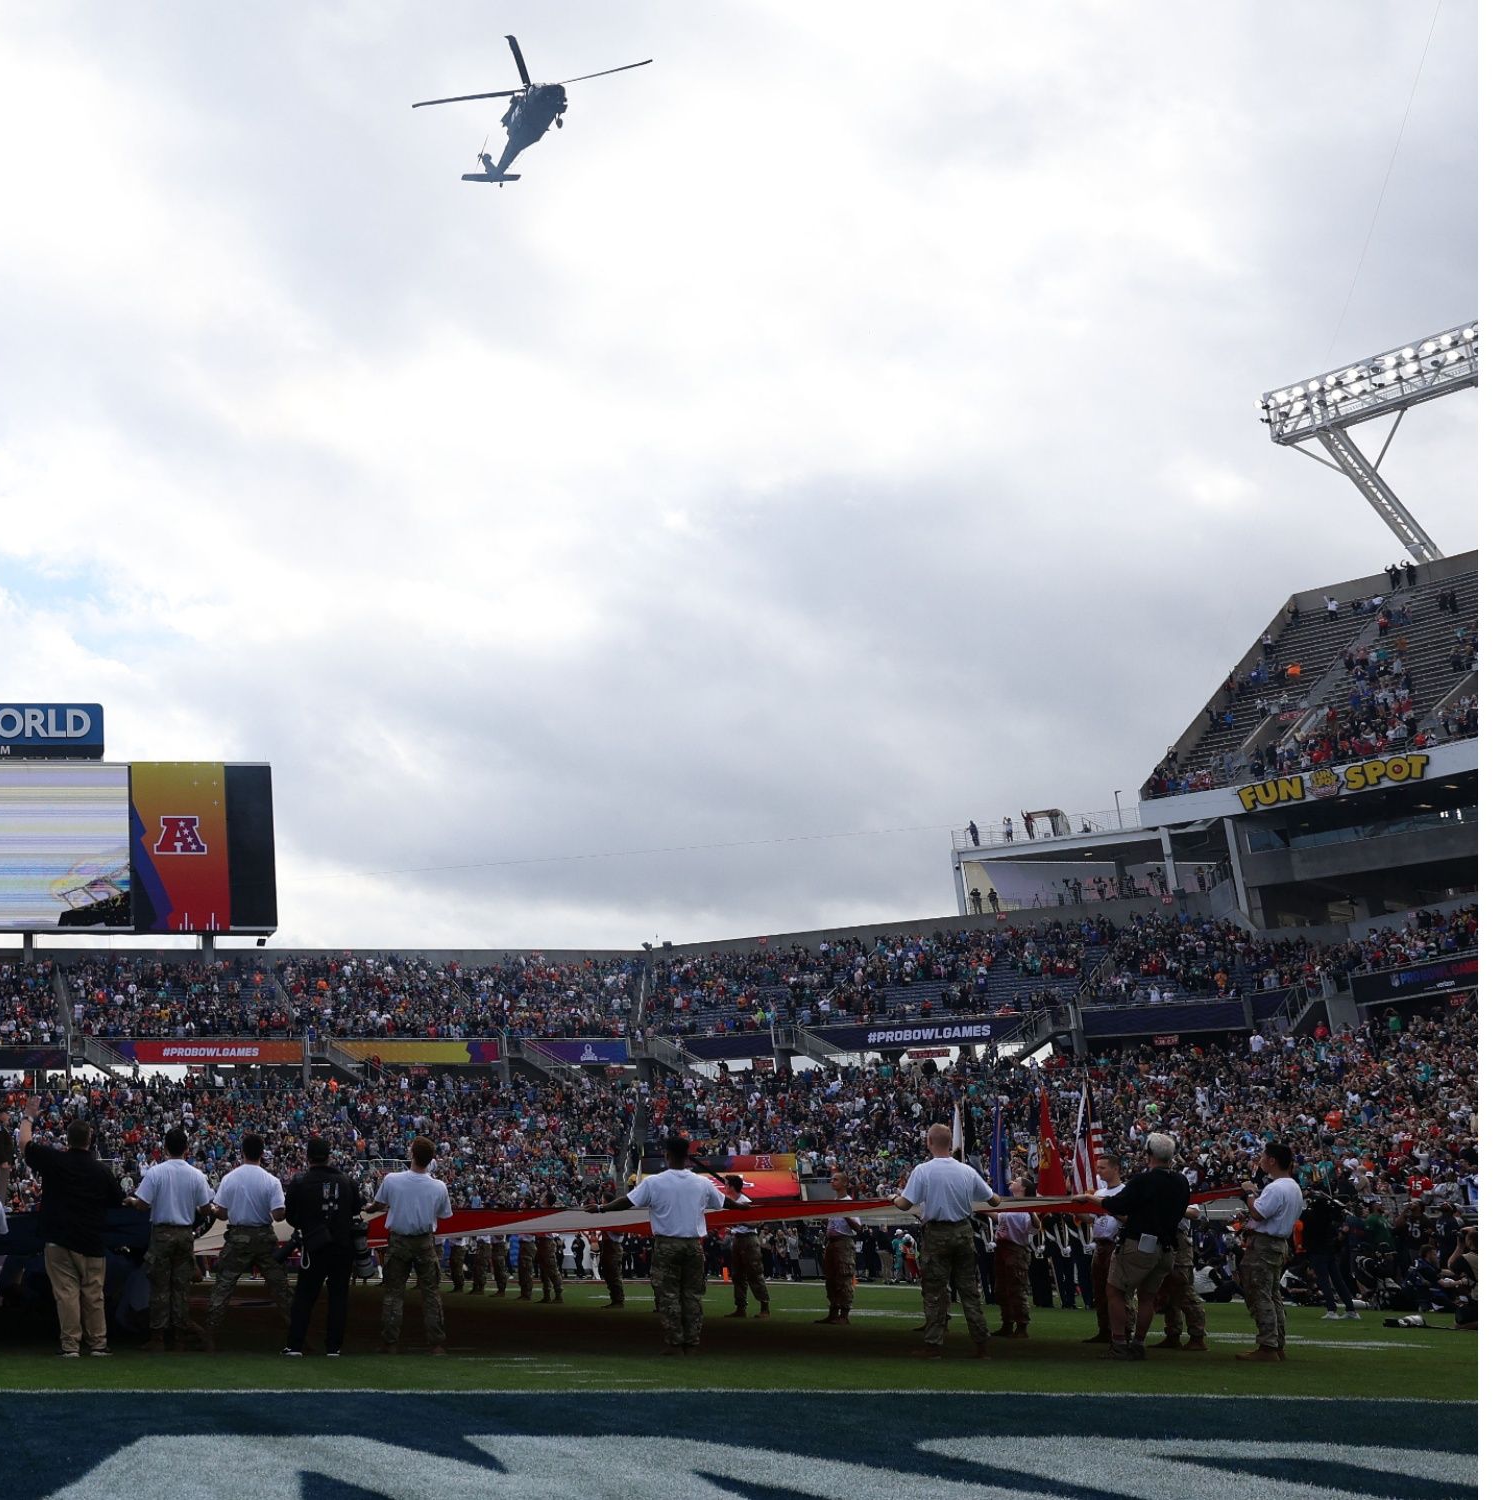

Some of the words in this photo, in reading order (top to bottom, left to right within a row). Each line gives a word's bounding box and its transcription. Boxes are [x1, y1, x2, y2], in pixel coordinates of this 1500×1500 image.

[1237, 776, 1304, 812] FUN
[1344, 753, 1429, 790] SPOT
[153, 815, 208, 855] A
[867, 1024, 991, 1043] #PROBOWLGAMES
[162, 1047, 260, 1057] #PROBOWLGAMES
[1411, 1180, 1422, 1191] 15
